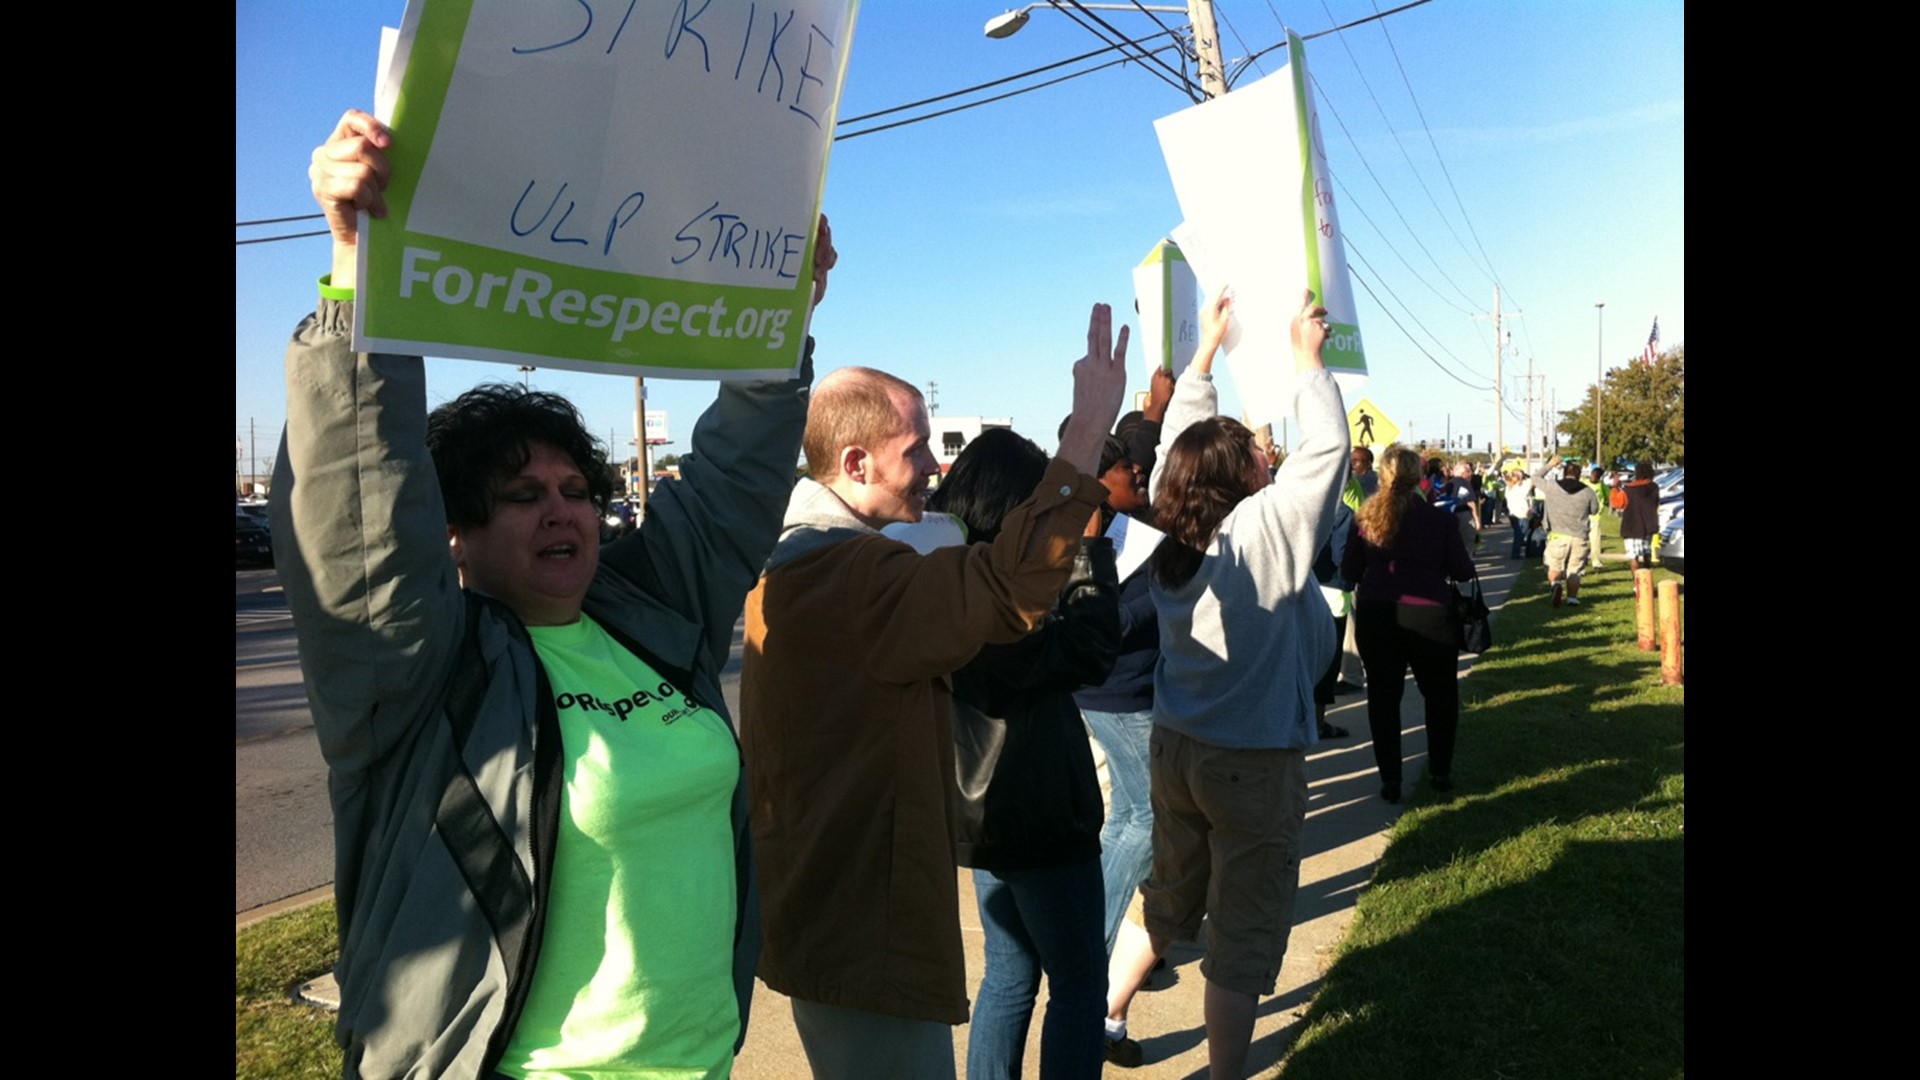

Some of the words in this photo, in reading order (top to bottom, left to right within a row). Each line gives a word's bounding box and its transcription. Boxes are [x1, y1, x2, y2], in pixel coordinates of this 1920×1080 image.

[510, 179, 644, 255] ULP
[671, 201, 805, 278] STRIKE
[400, 246, 792, 349] ForRespect.org
